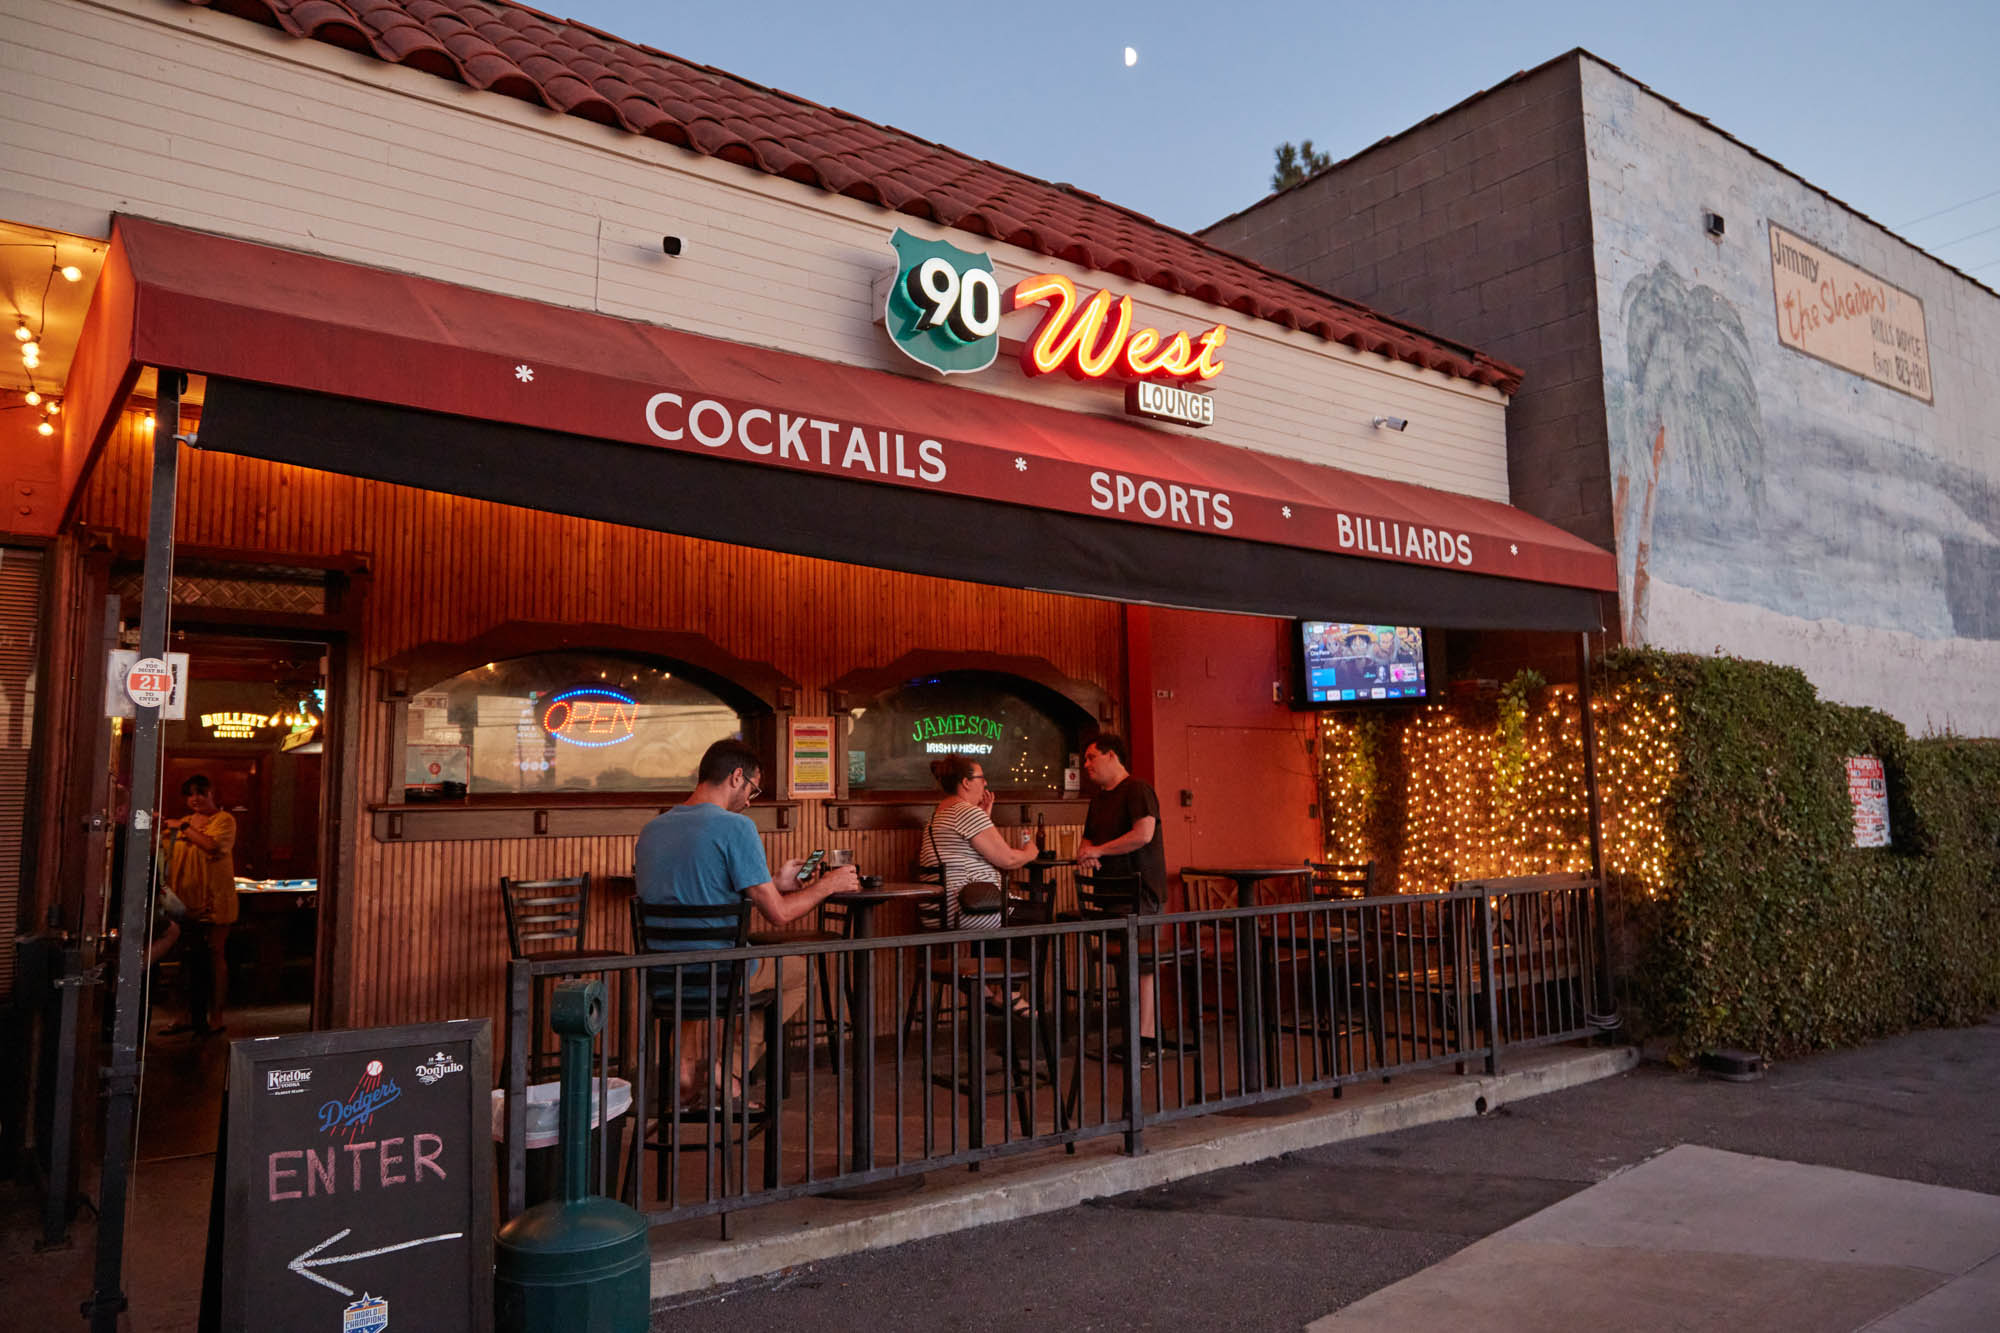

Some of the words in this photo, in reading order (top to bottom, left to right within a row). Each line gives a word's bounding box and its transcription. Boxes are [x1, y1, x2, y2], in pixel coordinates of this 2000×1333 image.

[1774, 232, 1819, 283] Jimmy
[918, 257, 999, 338] 90
[1013, 274, 1227, 380] West
[1784, 289, 1821, 351] the
[1142, 382, 1211, 422] LOUNGE
[645, 392, 947, 483] COCKTAILS
[1089, 471, 1234, 530] SPORTS
[1337, 513, 1473, 566] BILLIARDS
[139, 675, 161, 690] 21
[200, 712, 269, 728] BULLEIT
[213, 730, 255, 738] WHISKEY
[544, 701, 640, 734] OPEN
[912, 714, 1004, 741] JAMESON
[926, 742, 951, 753] IRISH
[269, 1071, 293, 1088] Ketel
[294, 1070, 312, 1081] One
[416, 1065, 439, 1076] Don
[434, 1063, 463, 1078] Julio
[318, 1079, 400, 1132] Dodgers
[268, 1133, 447, 1202] ENTER
[346, 1314, 387, 1330] CHAMPIONS
[354, 1308, 378, 1320] WORLD
